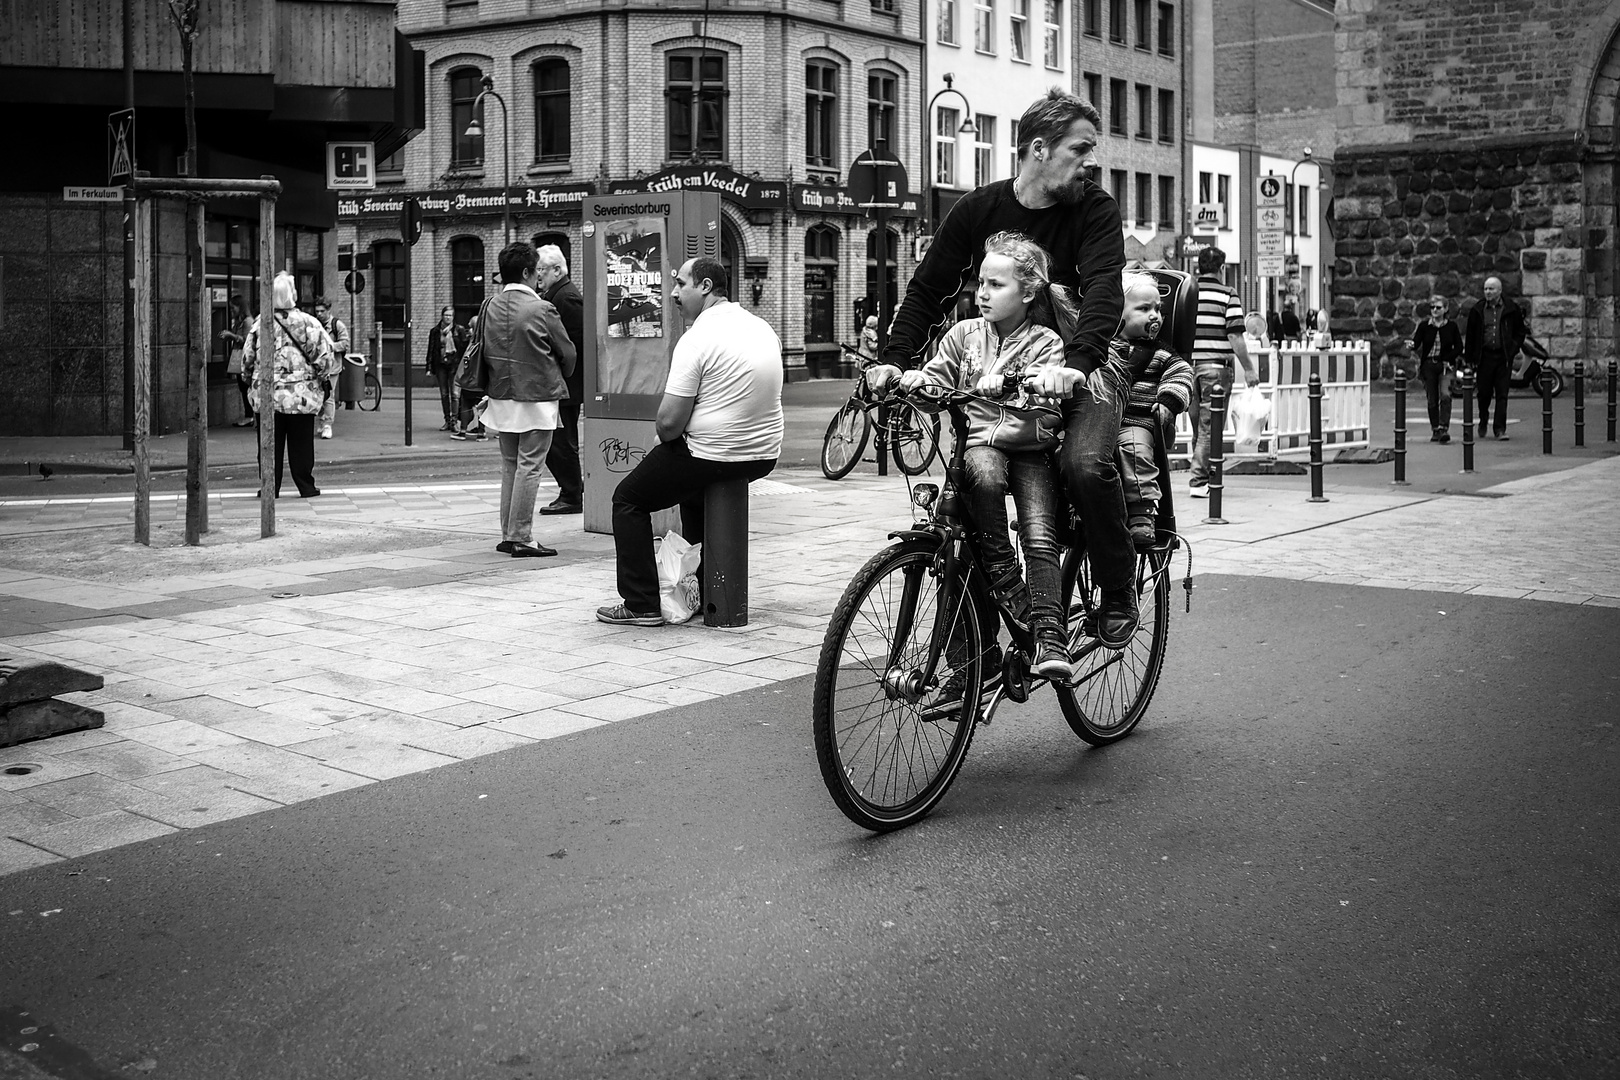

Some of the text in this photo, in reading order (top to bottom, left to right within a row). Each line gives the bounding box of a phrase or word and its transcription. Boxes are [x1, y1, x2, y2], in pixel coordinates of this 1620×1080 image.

[646, 171, 750, 198] früh em Veedel
[68, 188, 118, 198] Im Ferkulum
[801, 189, 823, 208] früh
[593, 201, 671, 217] Severinstorburg
[1198, 207, 1217, 220] dm
[606, 271, 662, 287] HOFFNUNG
